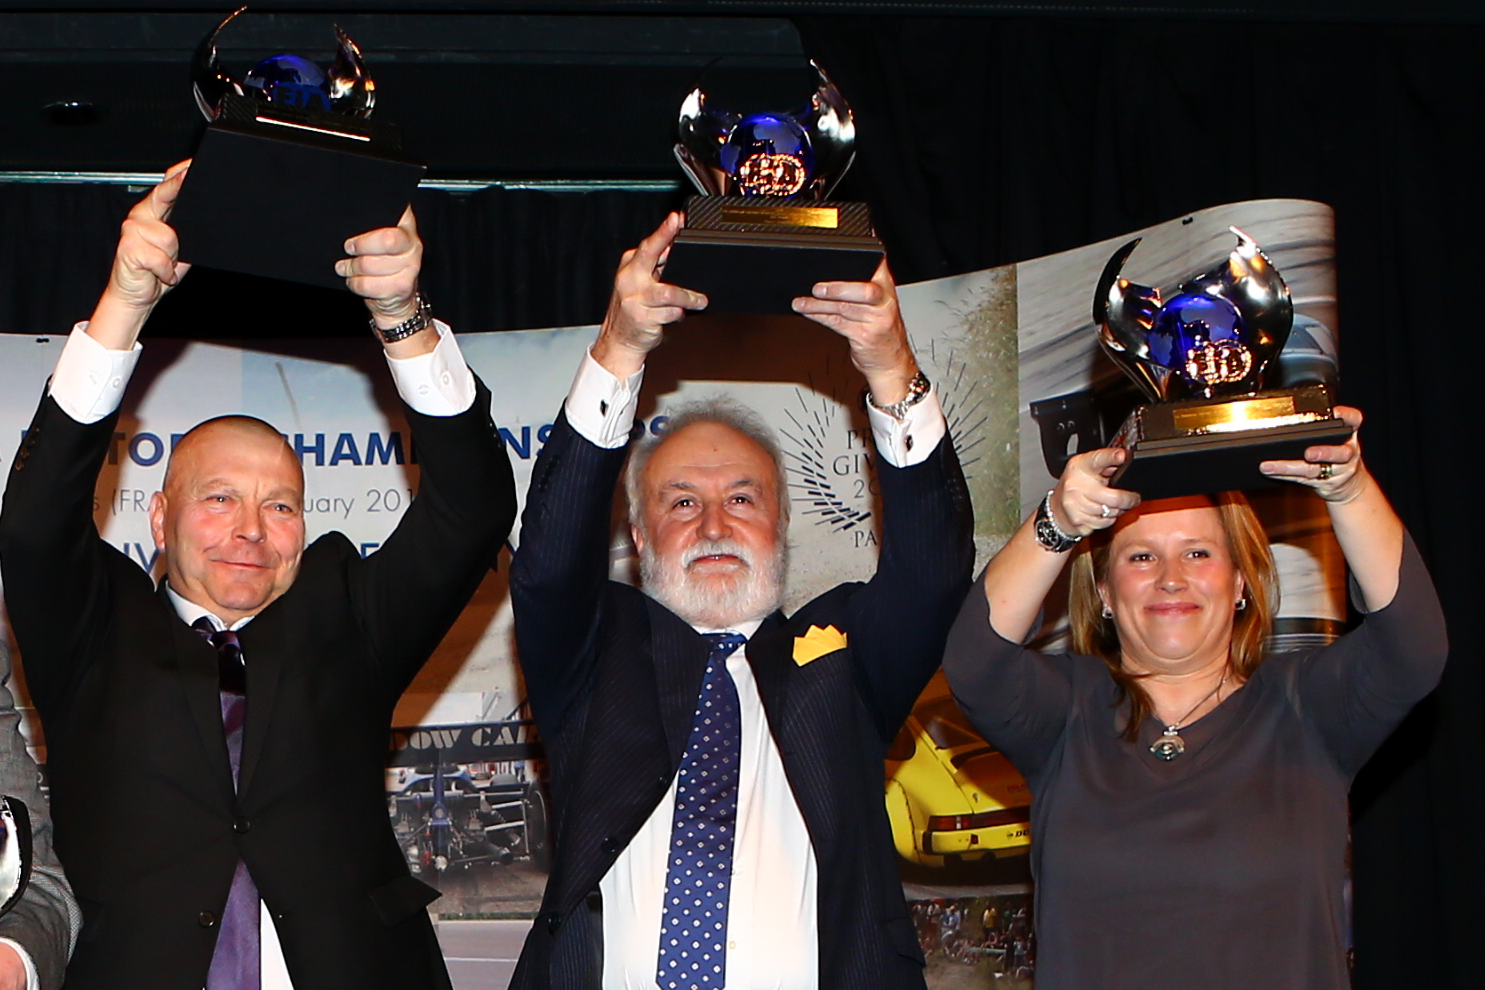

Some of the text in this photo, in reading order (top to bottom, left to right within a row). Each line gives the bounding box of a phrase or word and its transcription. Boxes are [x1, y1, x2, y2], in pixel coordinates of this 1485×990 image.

[282, 431, 417, 466] HAM
[112, 489, 152, 516] (FR
[854, 530, 877, 547] PA
